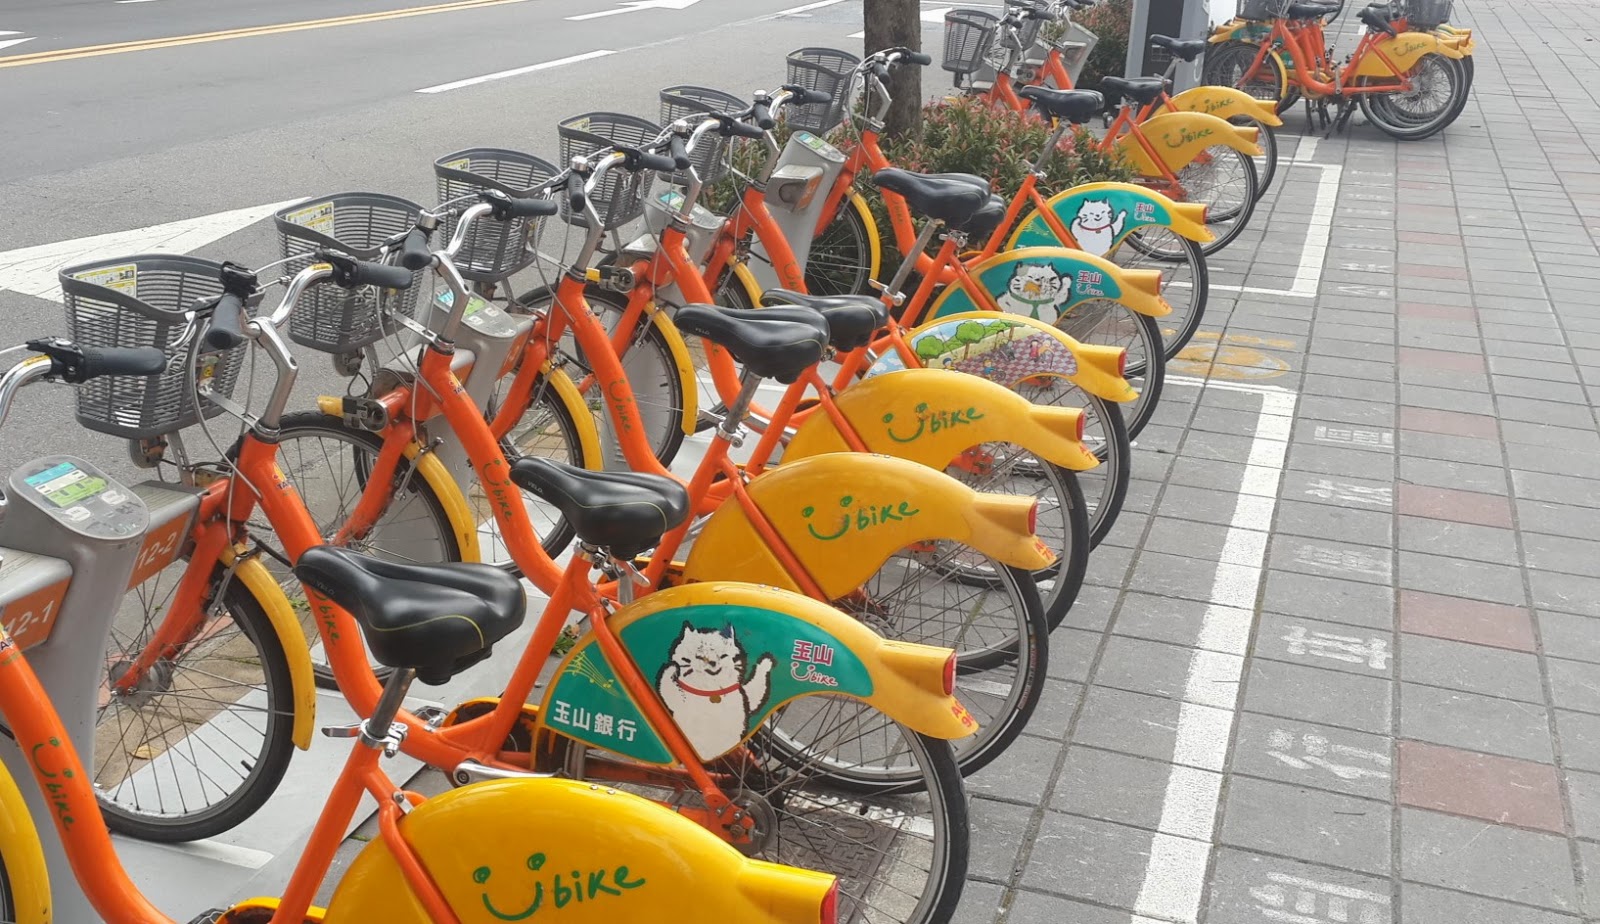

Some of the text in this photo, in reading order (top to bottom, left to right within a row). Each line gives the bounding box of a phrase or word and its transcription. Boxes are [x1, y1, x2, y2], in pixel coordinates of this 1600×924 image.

[1136, 202, 1154, 213] 玉山
[1077, 270, 1102, 284] 玉山
[527, 481, 544, 494] VELO
[138, 532, 178, 571] 12-2
[5, 600, 55, 637] 12-1
[791, 639, 834, 667] 玉山
[553, 700, 637, 742] 玉山銀行
[473, 853, 646, 922] Ubike
